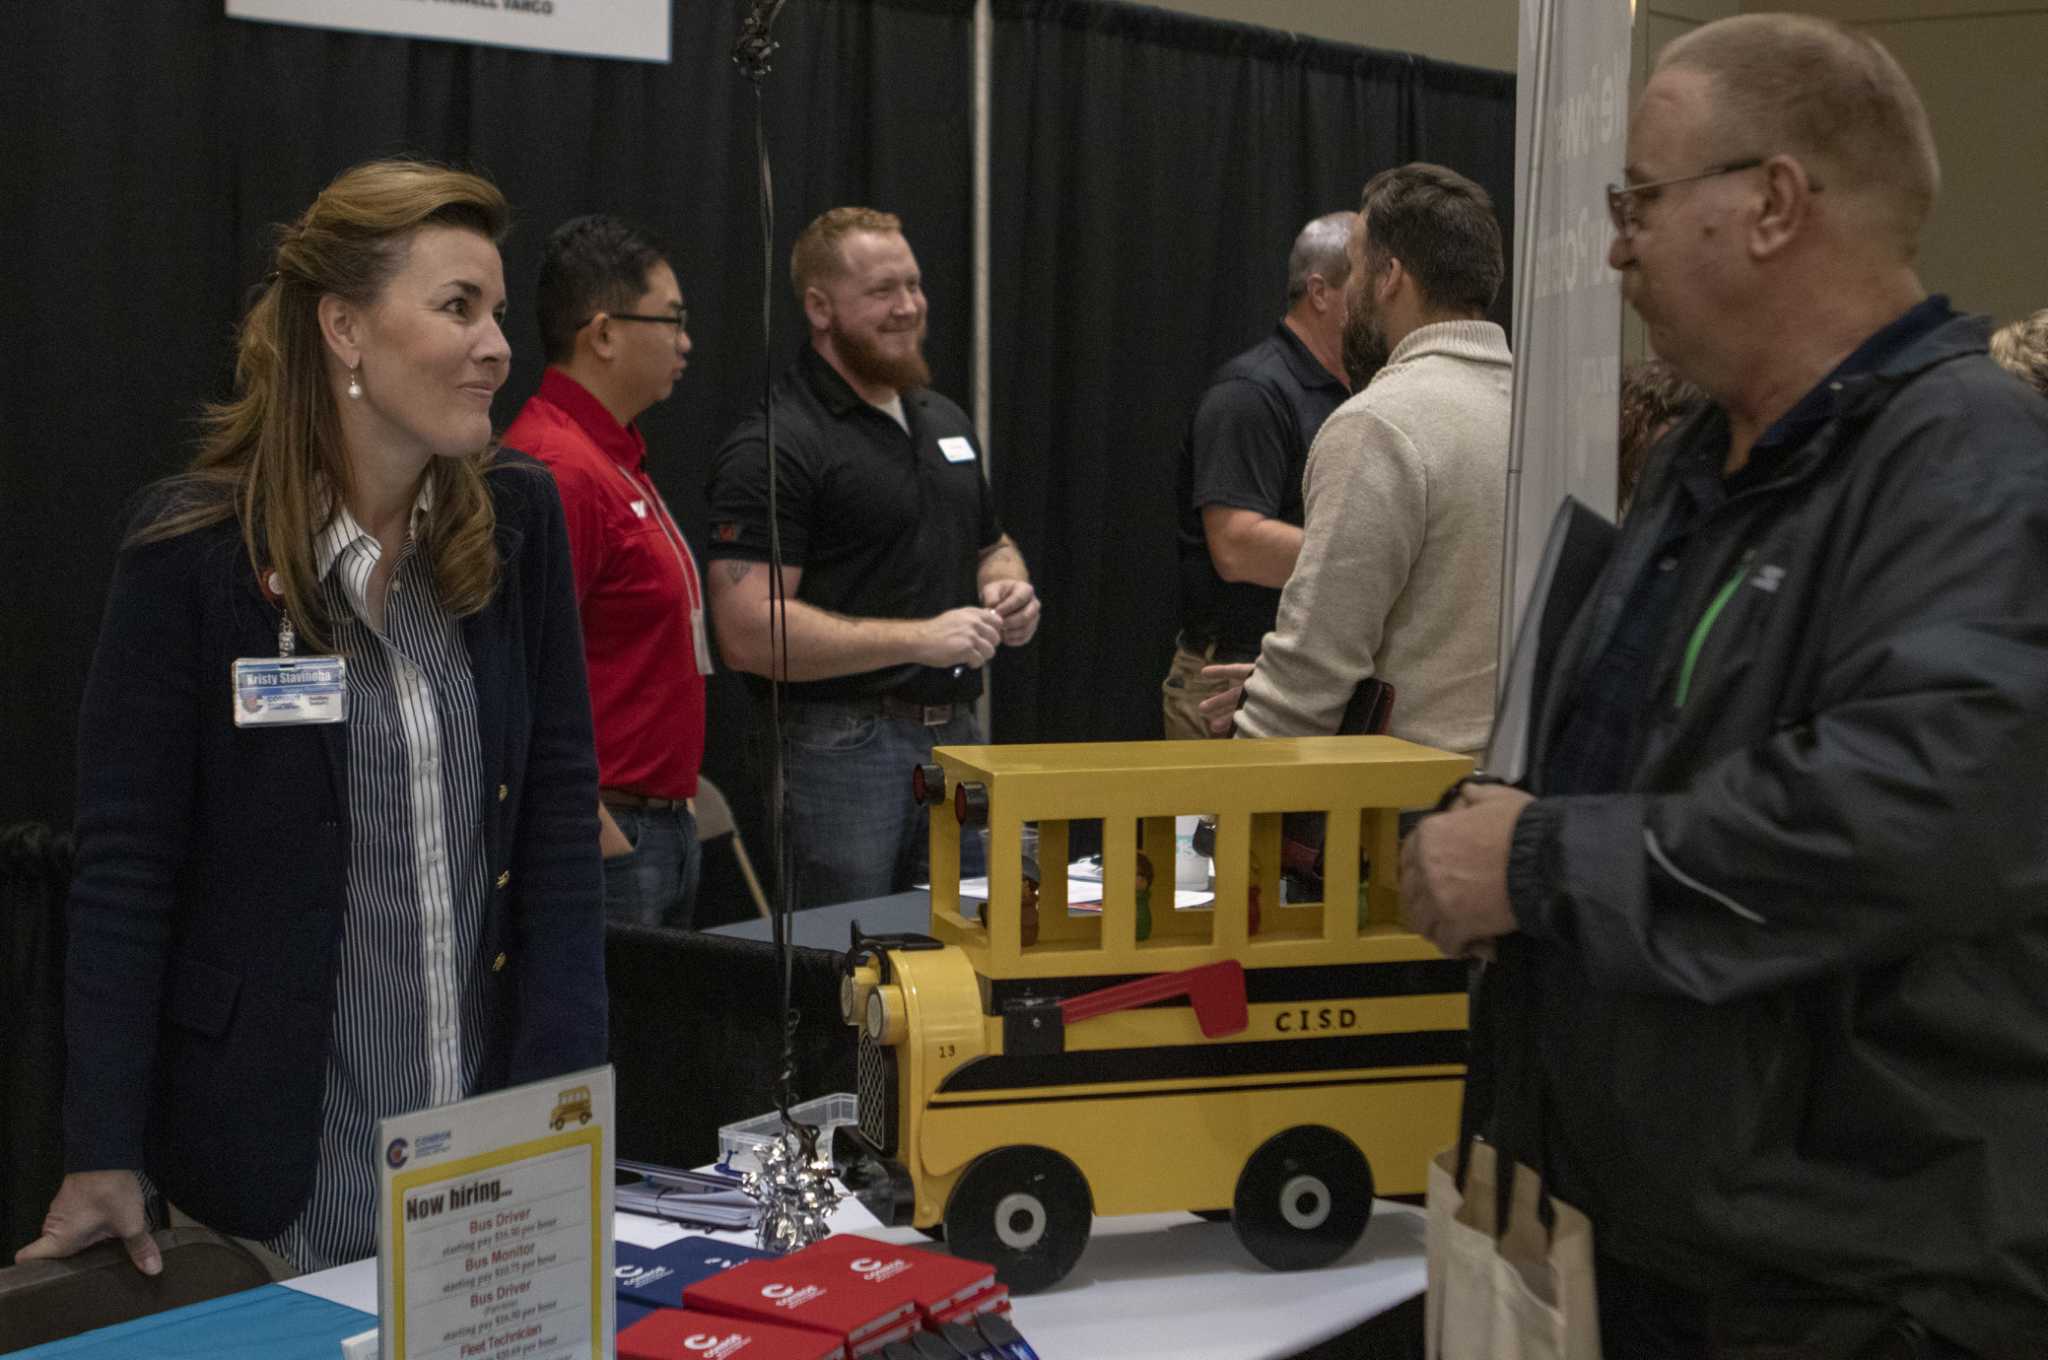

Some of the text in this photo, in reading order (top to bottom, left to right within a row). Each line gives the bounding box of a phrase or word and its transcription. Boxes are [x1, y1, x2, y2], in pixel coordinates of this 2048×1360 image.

[1275, 1008, 1357, 1032] CISD
[938, 1044, 955, 1058] 13
[406, 1179, 513, 1222] Now hiring...
[469, 1208, 532, 1235] Bus Driver
[465, 1242, 536, 1273] Bus Monitor
[469, 1292, 494, 1308] Bus
[496, 1280, 532, 1300] Driver
[488, 1324, 542, 1350] Technician
